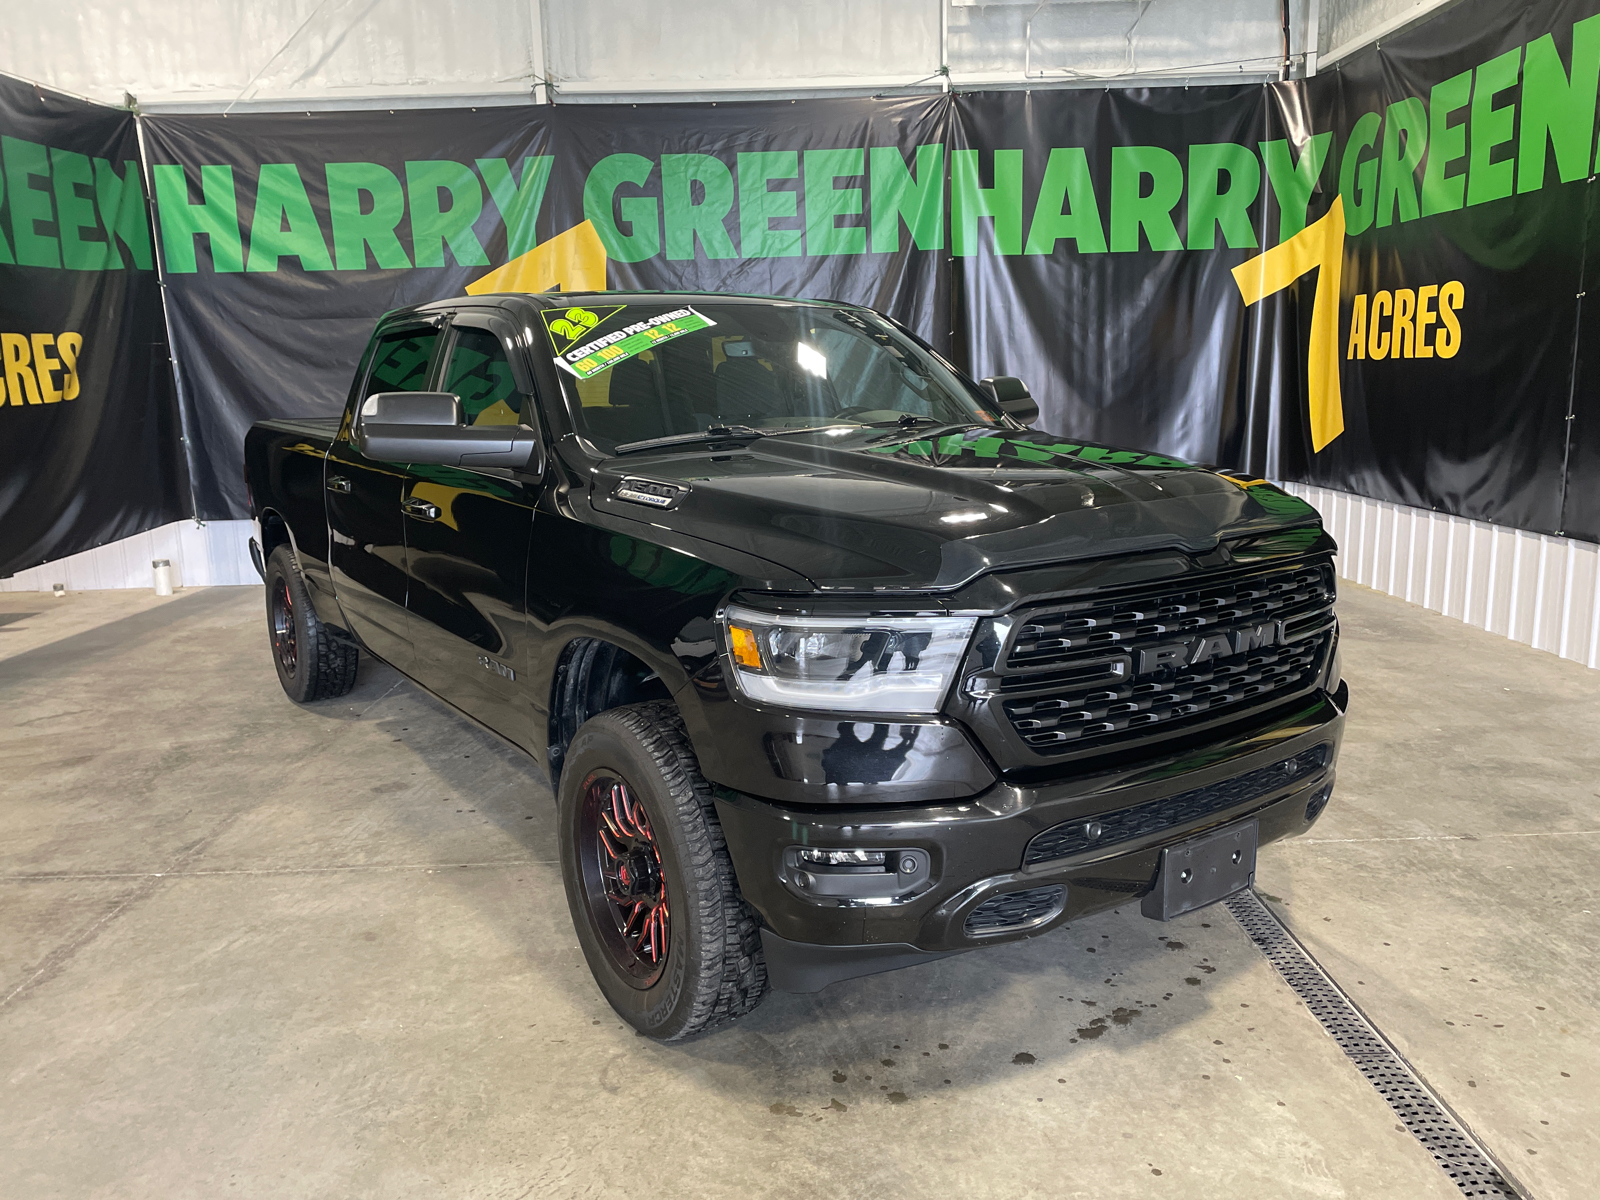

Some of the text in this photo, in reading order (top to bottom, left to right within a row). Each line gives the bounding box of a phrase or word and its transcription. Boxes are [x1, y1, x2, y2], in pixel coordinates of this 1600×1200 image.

[952, 131, 1333, 256] HARRY
[1338, 13, 1600, 237] GREEN
[0, 135, 154, 271] EEN
[153, 155, 555, 273] HARRY
[583, 143, 944, 263] GREEN
[549, 307, 599, 340] 23
[566, 331, 627, 362] CERTIFIED
[622, 309, 691, 336] PRE-OWNED
[644, 329, 663, 341] 12
[661, 323, 682, 334] 12
[1231, 193, 1345, 454] 7
[1347, 281, 1465, 360] ACRES
[0, 332, 83, 408] RES
[575, 345, 624, 372] 60 100
[477, 655, 516, 681] RAM
[1138, 621, 1276, 675] RAM
